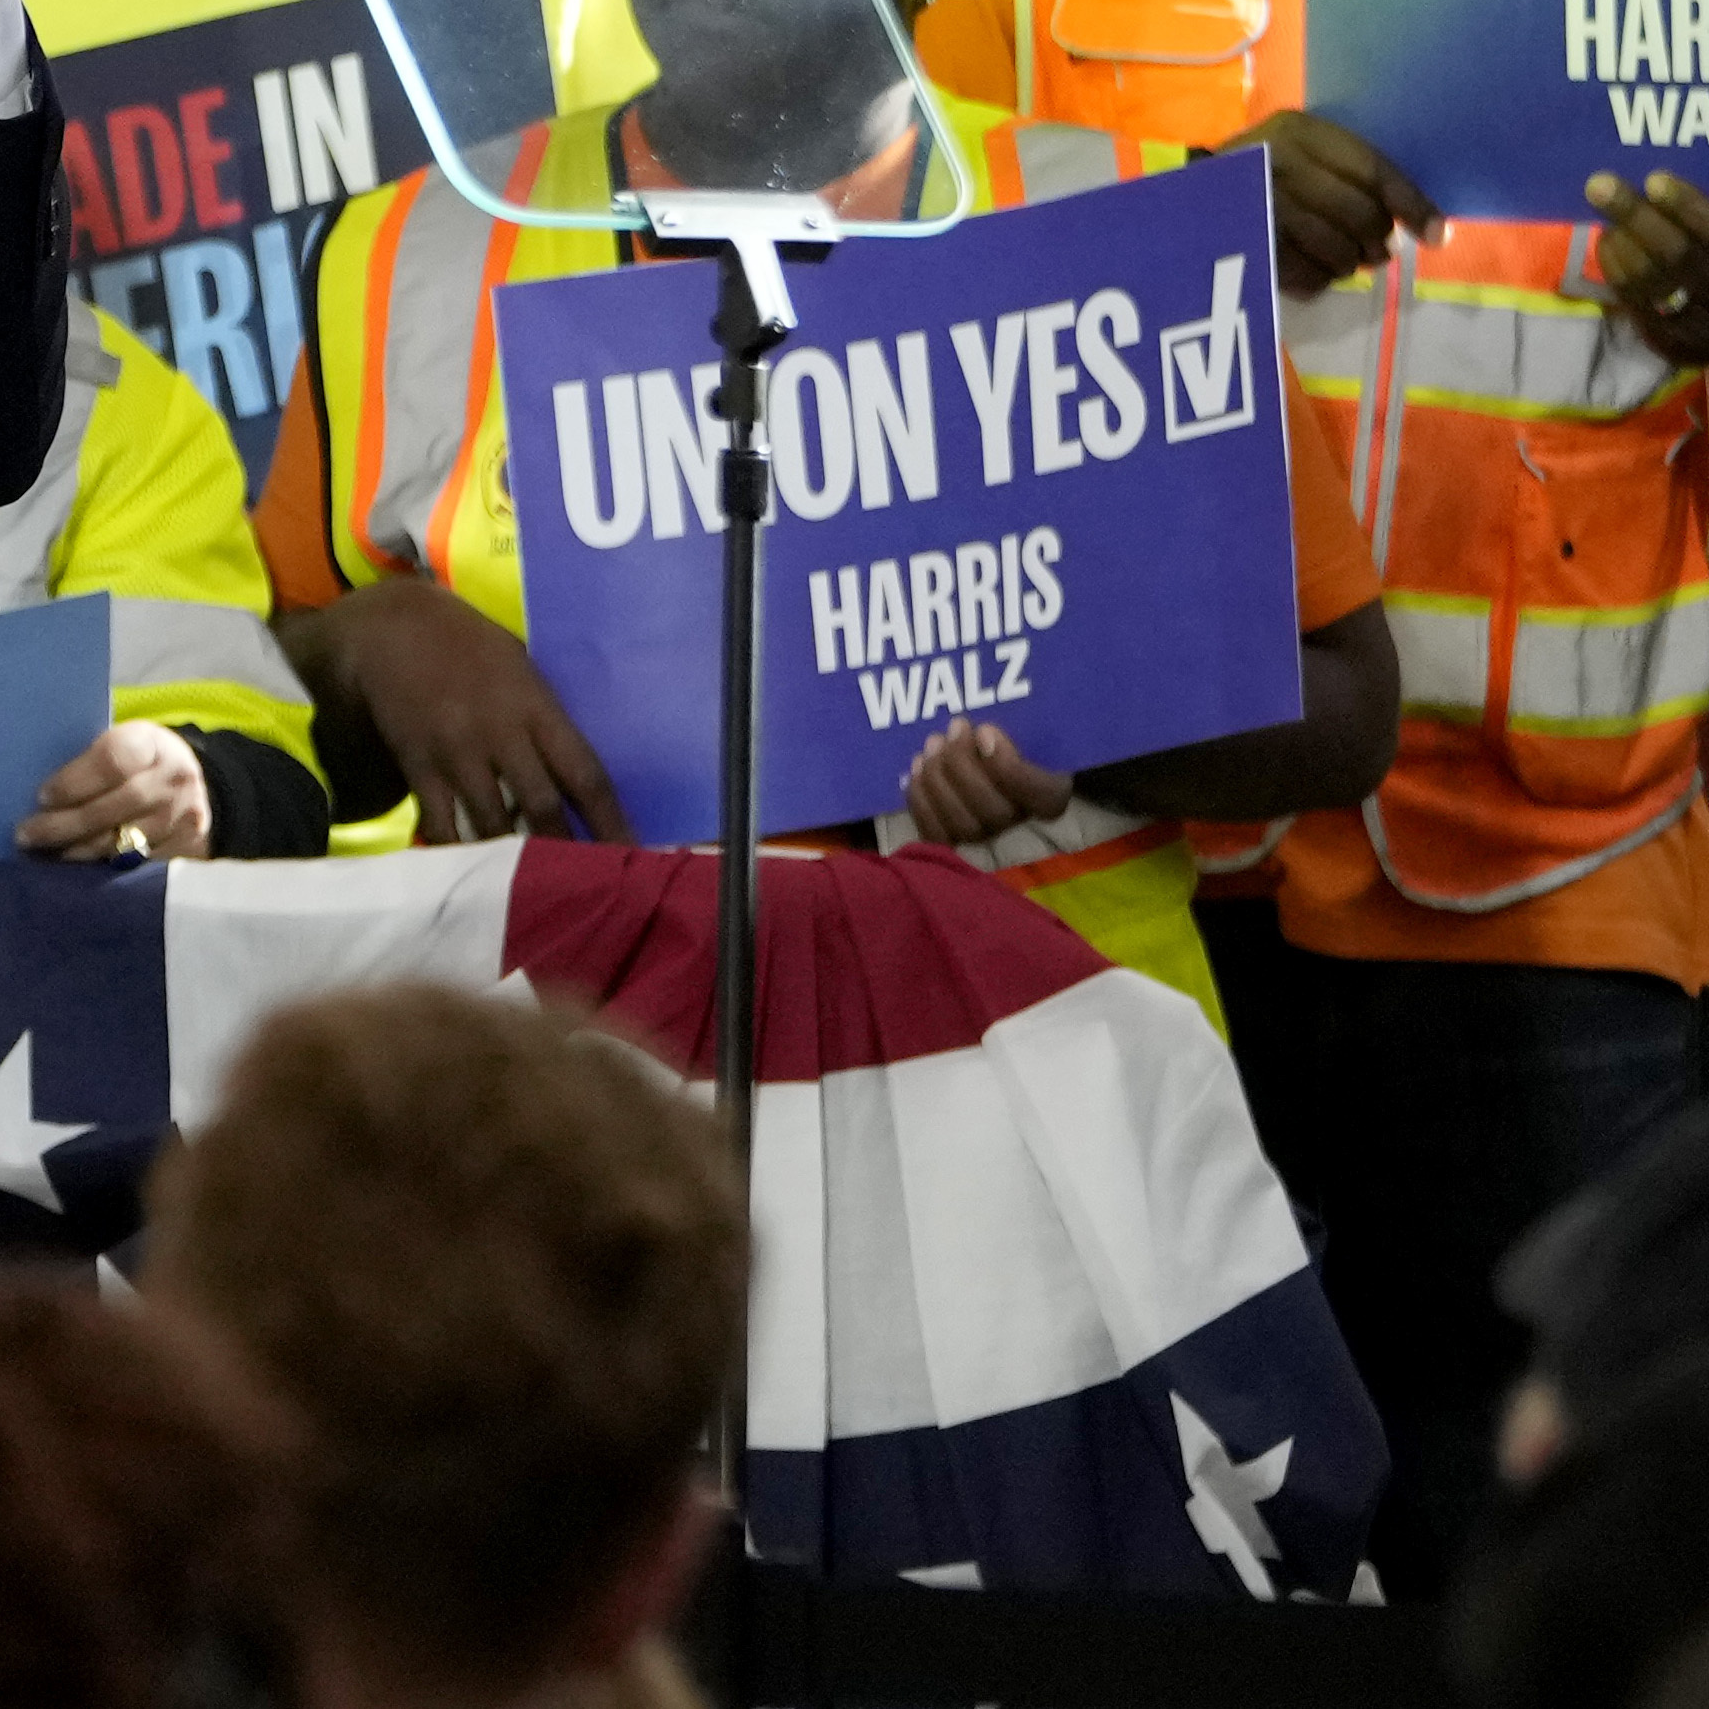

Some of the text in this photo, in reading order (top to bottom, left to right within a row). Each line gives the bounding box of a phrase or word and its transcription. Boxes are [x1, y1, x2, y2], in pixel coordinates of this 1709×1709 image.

[254, 53, 380, 212] IN
[553, 288, 1147, 549] UNON YES
[809, 525, 1063, 674] HARRIS
[859, 639, 1031, 729] WALZ
